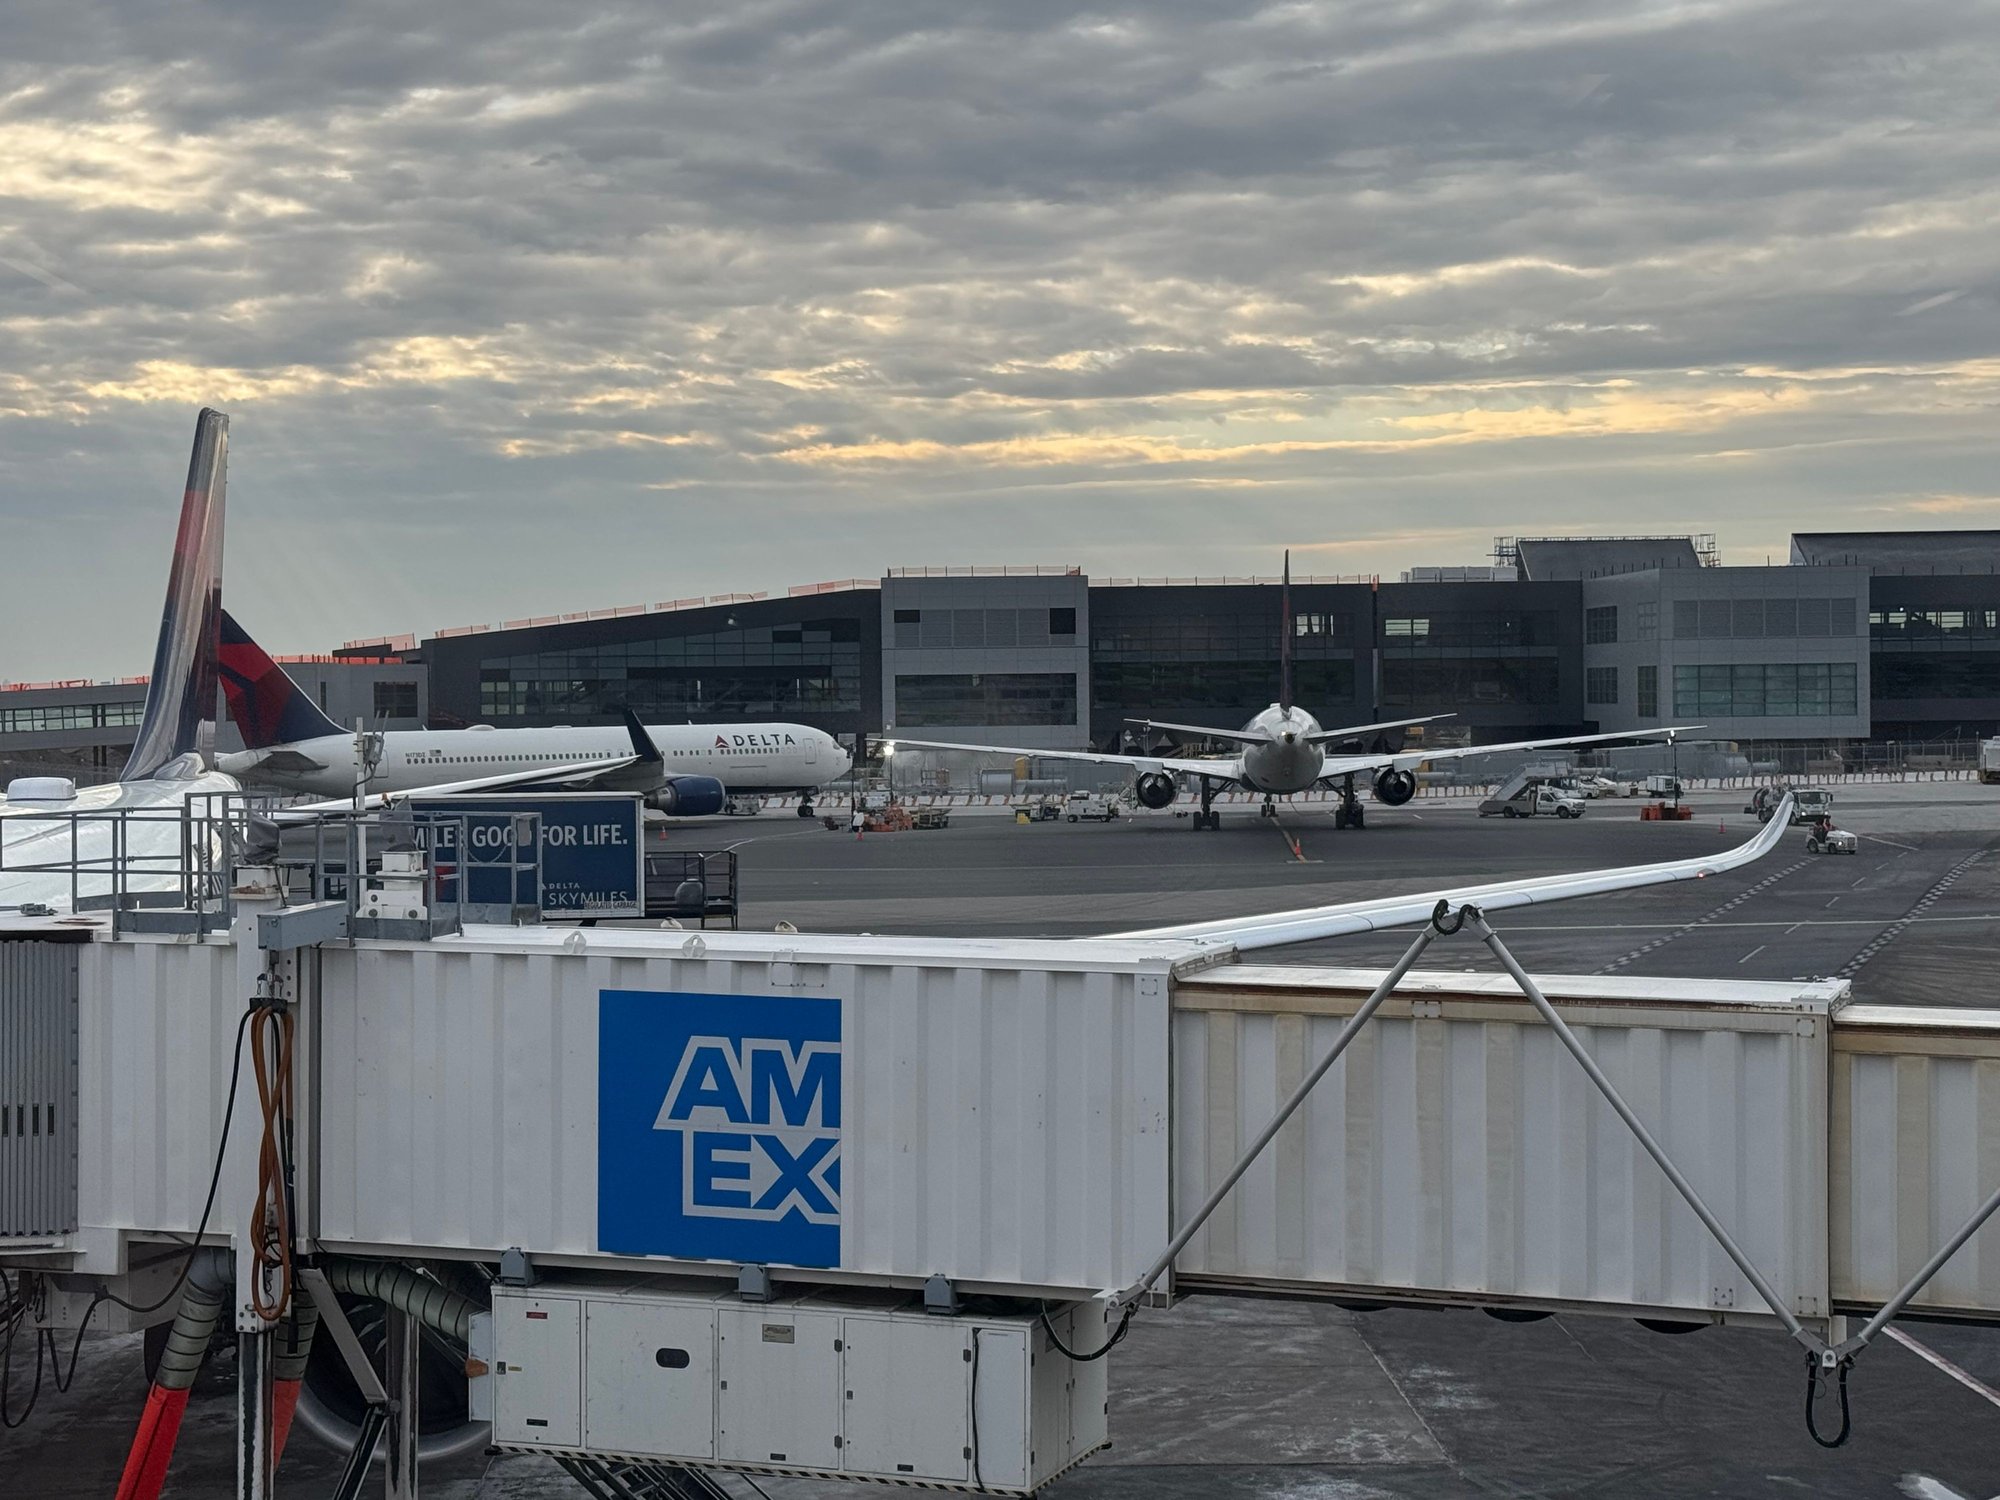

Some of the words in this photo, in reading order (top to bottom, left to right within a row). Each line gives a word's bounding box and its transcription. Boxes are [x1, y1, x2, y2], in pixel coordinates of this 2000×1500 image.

[732, 734, 796, 746] DELTA
[472, 826, 532, 847] GOO
[541, 825, 577, 847] FOR
[583, 824, 628, 846] LIFE.
[549, 891, 627, 905] SKYMILES
[653, 1036, 841, 1132] AM
[683, 1131, 841, 1226] EX
